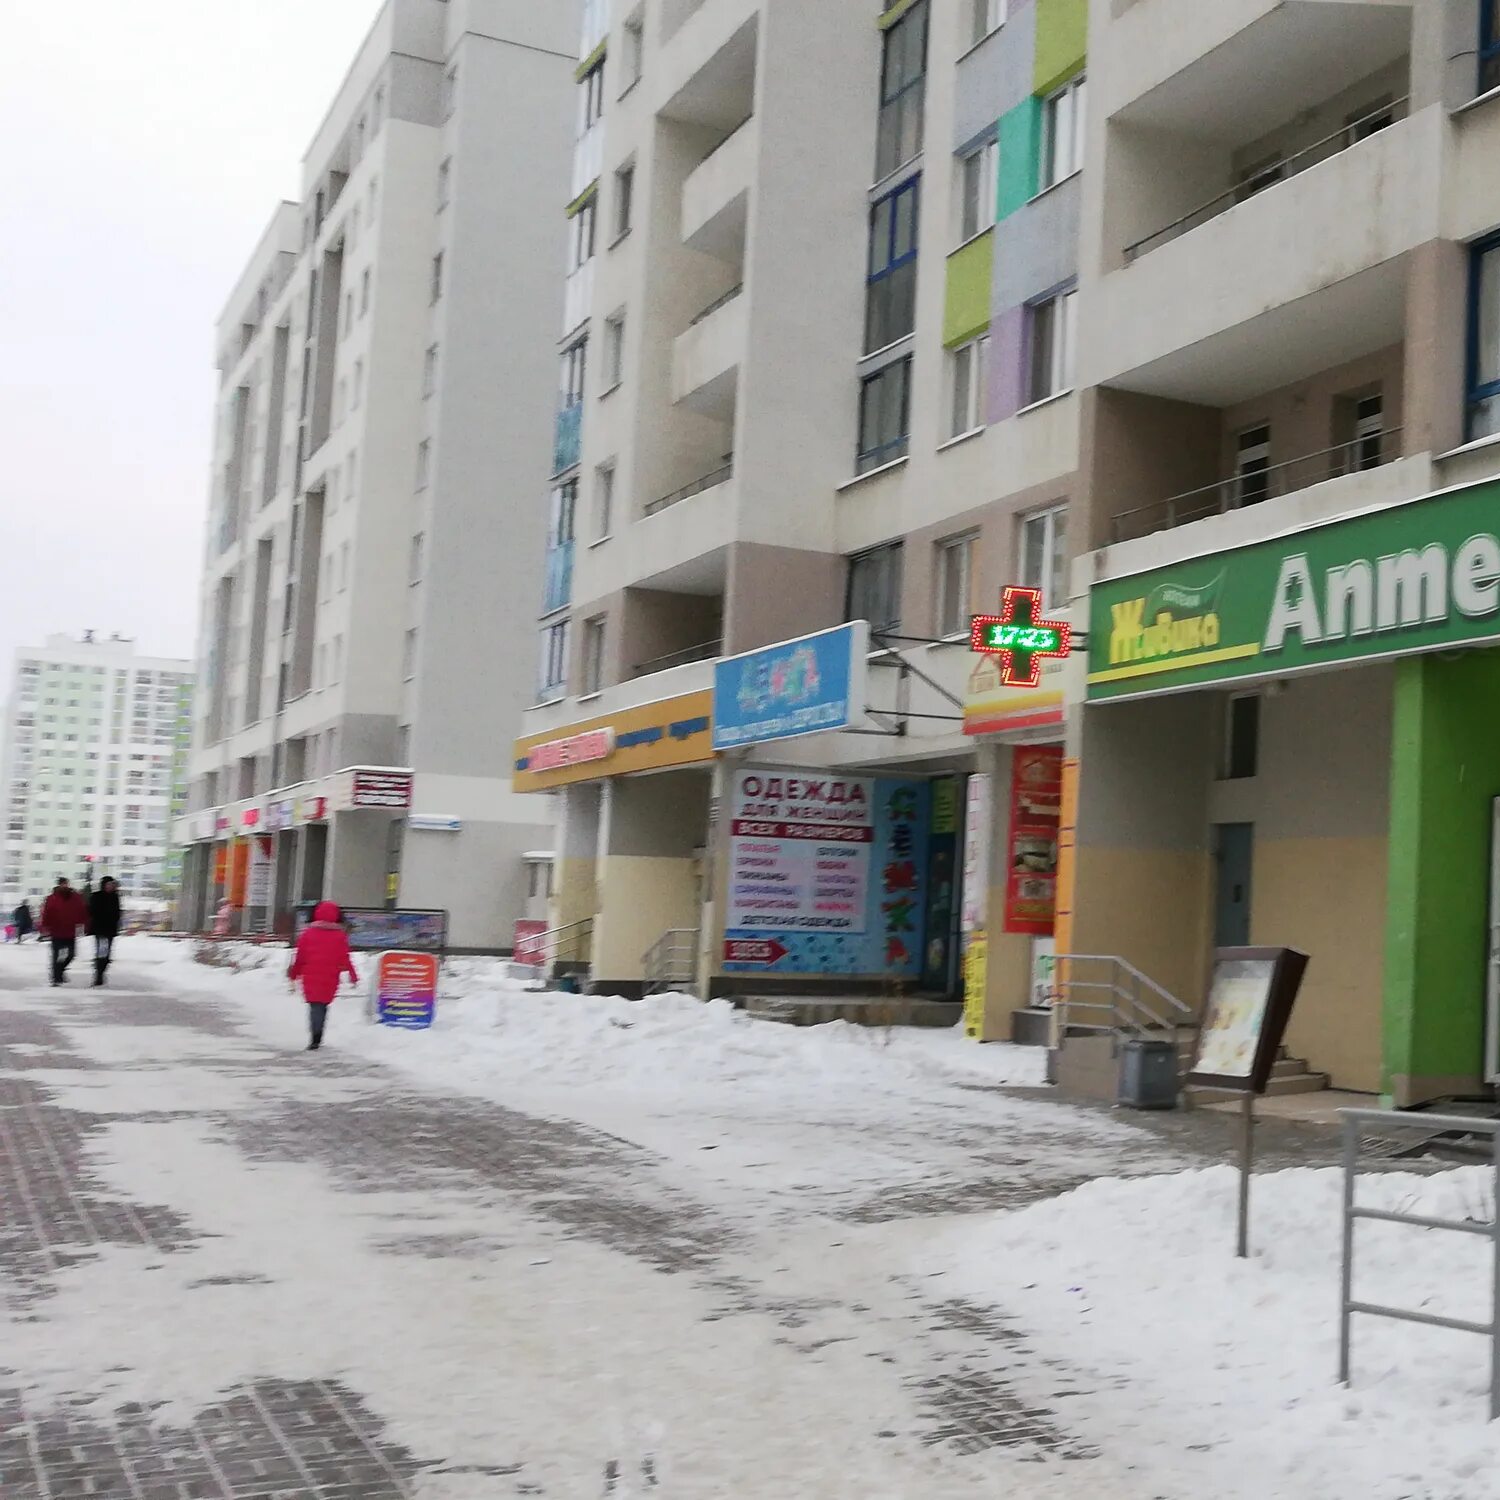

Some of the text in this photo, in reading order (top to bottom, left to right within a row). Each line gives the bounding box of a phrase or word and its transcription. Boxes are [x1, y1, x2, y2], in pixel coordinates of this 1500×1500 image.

[989, 624, 1054, 649] 17:23
[1109, 597, 1219, 664] Живика
[742, 776, 866, 805] ОДЕЖДА
[740, 803, 868, 822] ДЛЯ ЖЕНЩИН
[738, 821, 866, 841] ВСЕХ РАЗМЕРОВ
